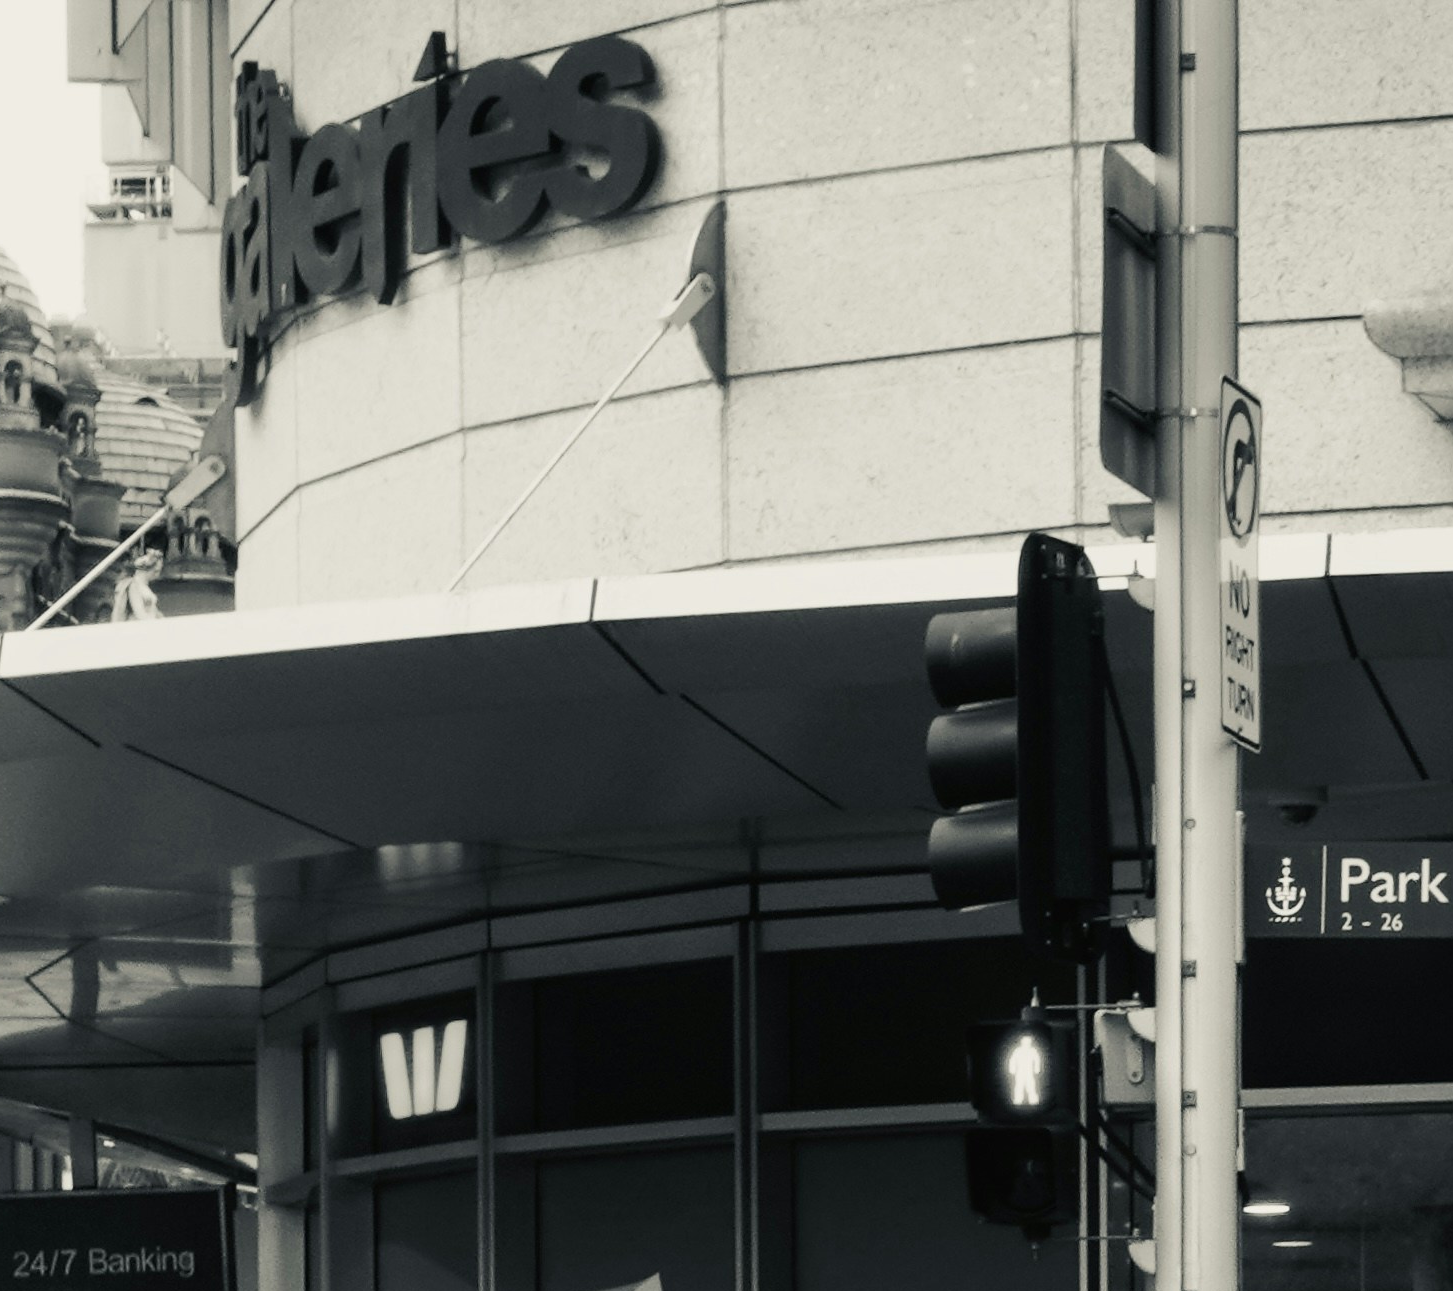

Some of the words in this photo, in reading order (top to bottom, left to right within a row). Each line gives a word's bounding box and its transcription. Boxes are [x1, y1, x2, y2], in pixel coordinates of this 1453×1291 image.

[220, 31, 664, 407] galeries
[1228, 560, 1250, 618] NO
[1225, 624, 1255, 677] RIGHT
[1226, 676, 1256, 722] TURN
[1340, 857, 1448, 904] Park
[1341, 913, 1352, 931] 2
[1380, 912, 1403, 931] 26
[12, 1249, 79, 1278] 24/7
[88, 1247, 196, 1278] Banking
